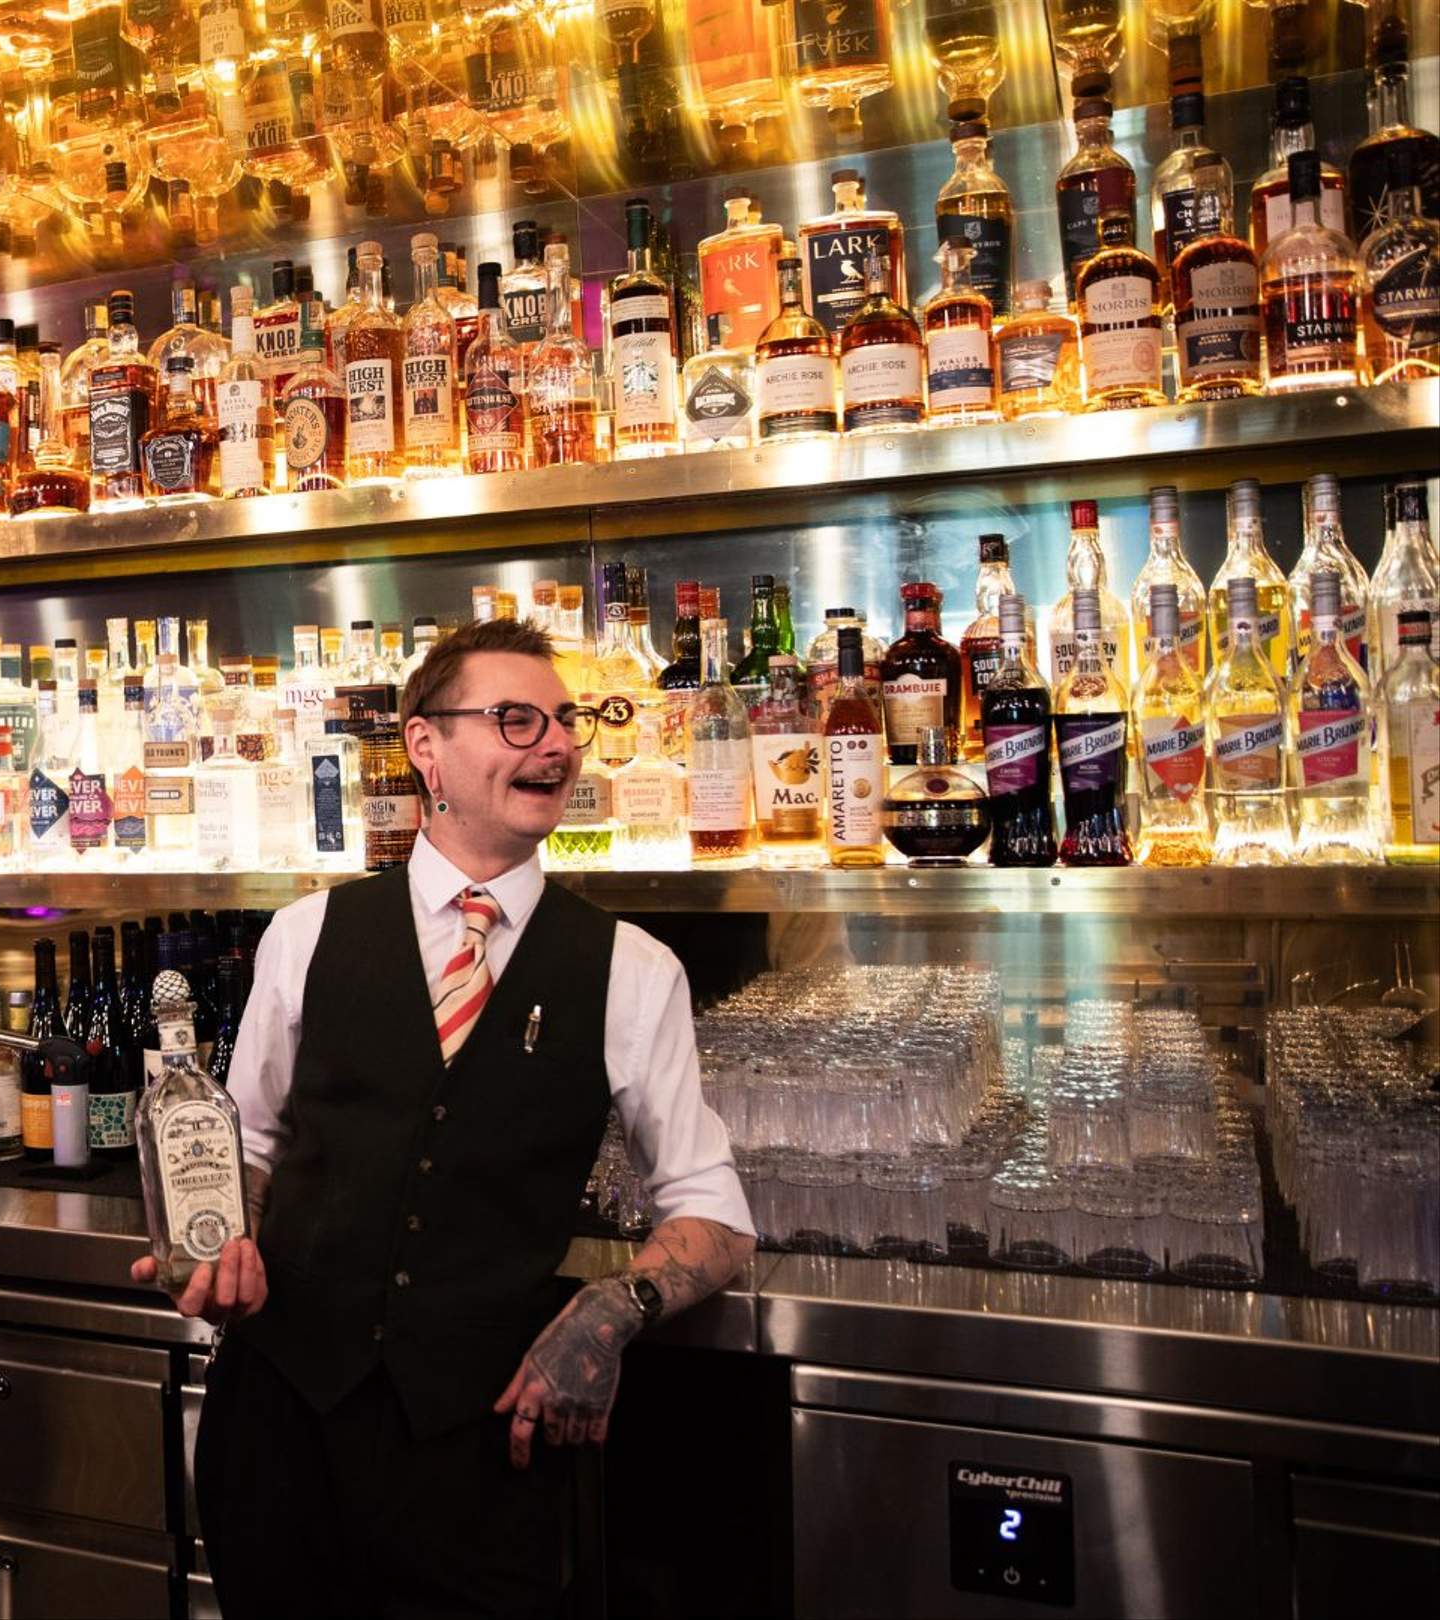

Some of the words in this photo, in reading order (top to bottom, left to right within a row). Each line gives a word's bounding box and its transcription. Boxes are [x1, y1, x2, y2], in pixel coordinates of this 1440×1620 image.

[813, 233, 882, 260] LARK
[1092, 298, 1148, 313] MORRIS
[255, 329, 296, 354] KNOB
[405, 359, 447, 376] HIGH
[881, 360, 906, 370] ROSE
[348, 366, 385, 383] HIGH
[406, 372, 447, 385] WEST
[800, 370, 824, 381] ROSE
[348, 380, 385, 395] WEST
[285, 686, 327, 709] mgc
[601, 702, 628, 722] 43
[1147, 737, 1175, 756] MARIE
[30, 787, 58, 801] EVER
[70, 779, 101, 794] EVER
[830, 740, 846, 841] AMARETTO
[772, 788, 819, 804] Mac.
[30, 805, 59, 818] EVER
[70, 799, 103, 815] EVER
[957, 1468, 1063, 1494] CyberChill
[999, 1508, 1023, 1540] 2
